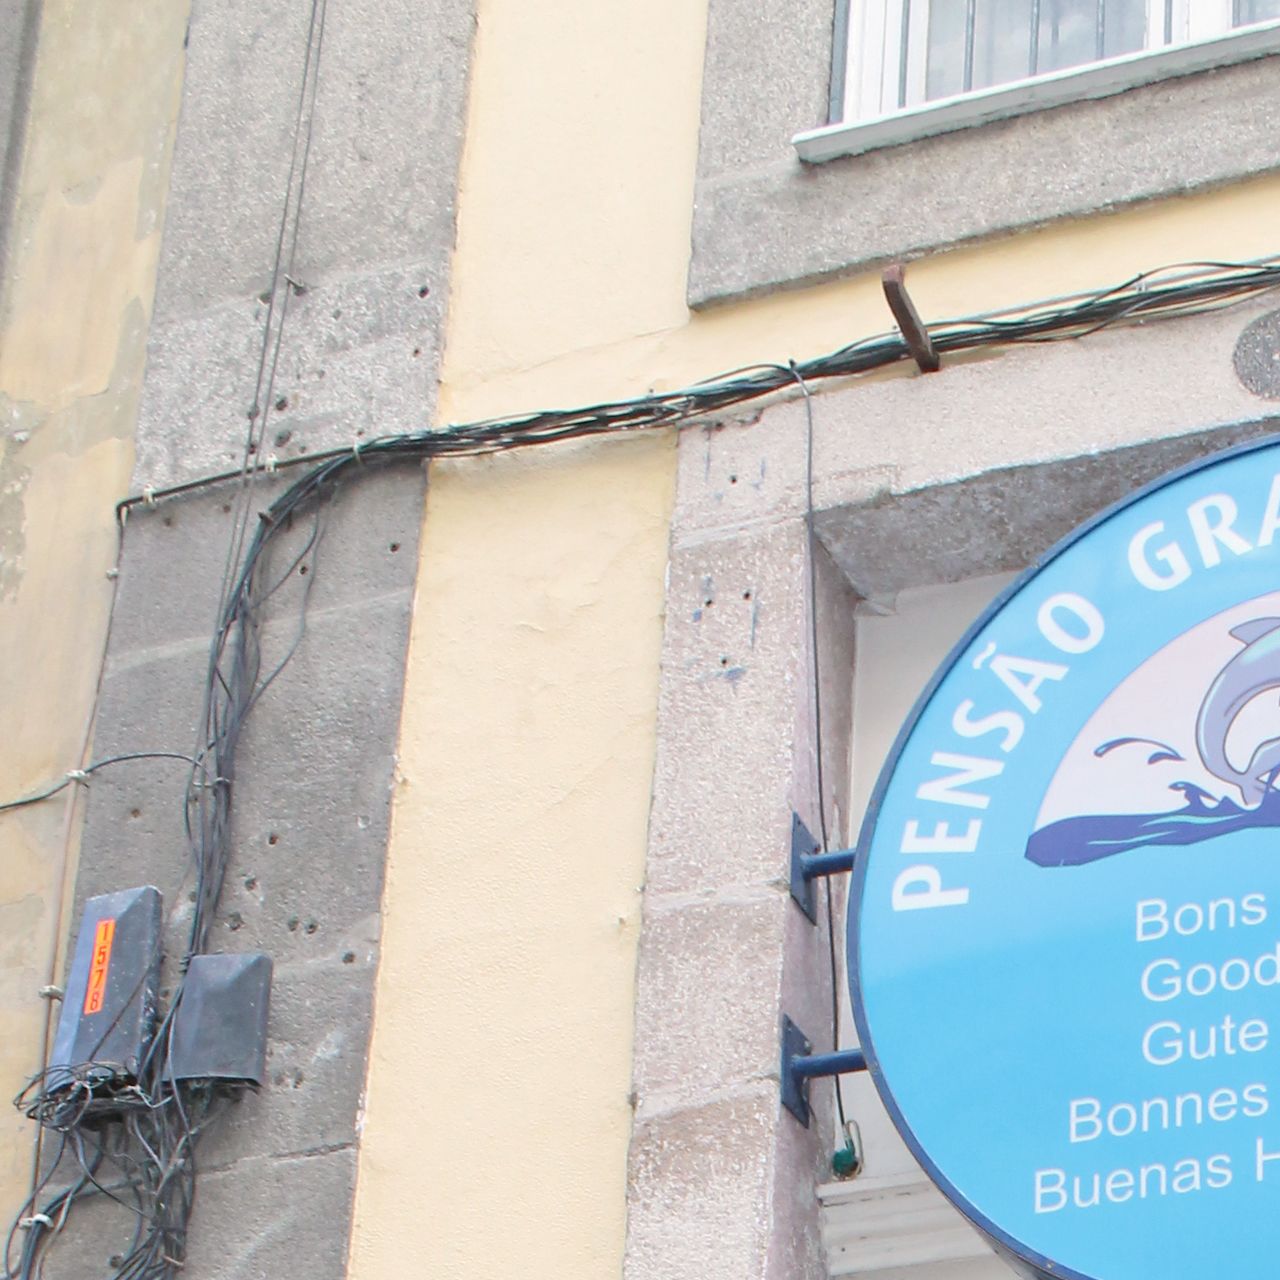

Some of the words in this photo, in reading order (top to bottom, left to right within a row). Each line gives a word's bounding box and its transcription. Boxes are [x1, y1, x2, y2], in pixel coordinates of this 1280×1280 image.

[893, 592, 1106, 911] PENSÃO
[1135, 892, 1268, 942] Bons
[1142, 1014, 1269, 1066] Gute
[1069, 1082, 1269, 1143] Bonnes
[1034, 1152, 1233, 1214] Buenas
